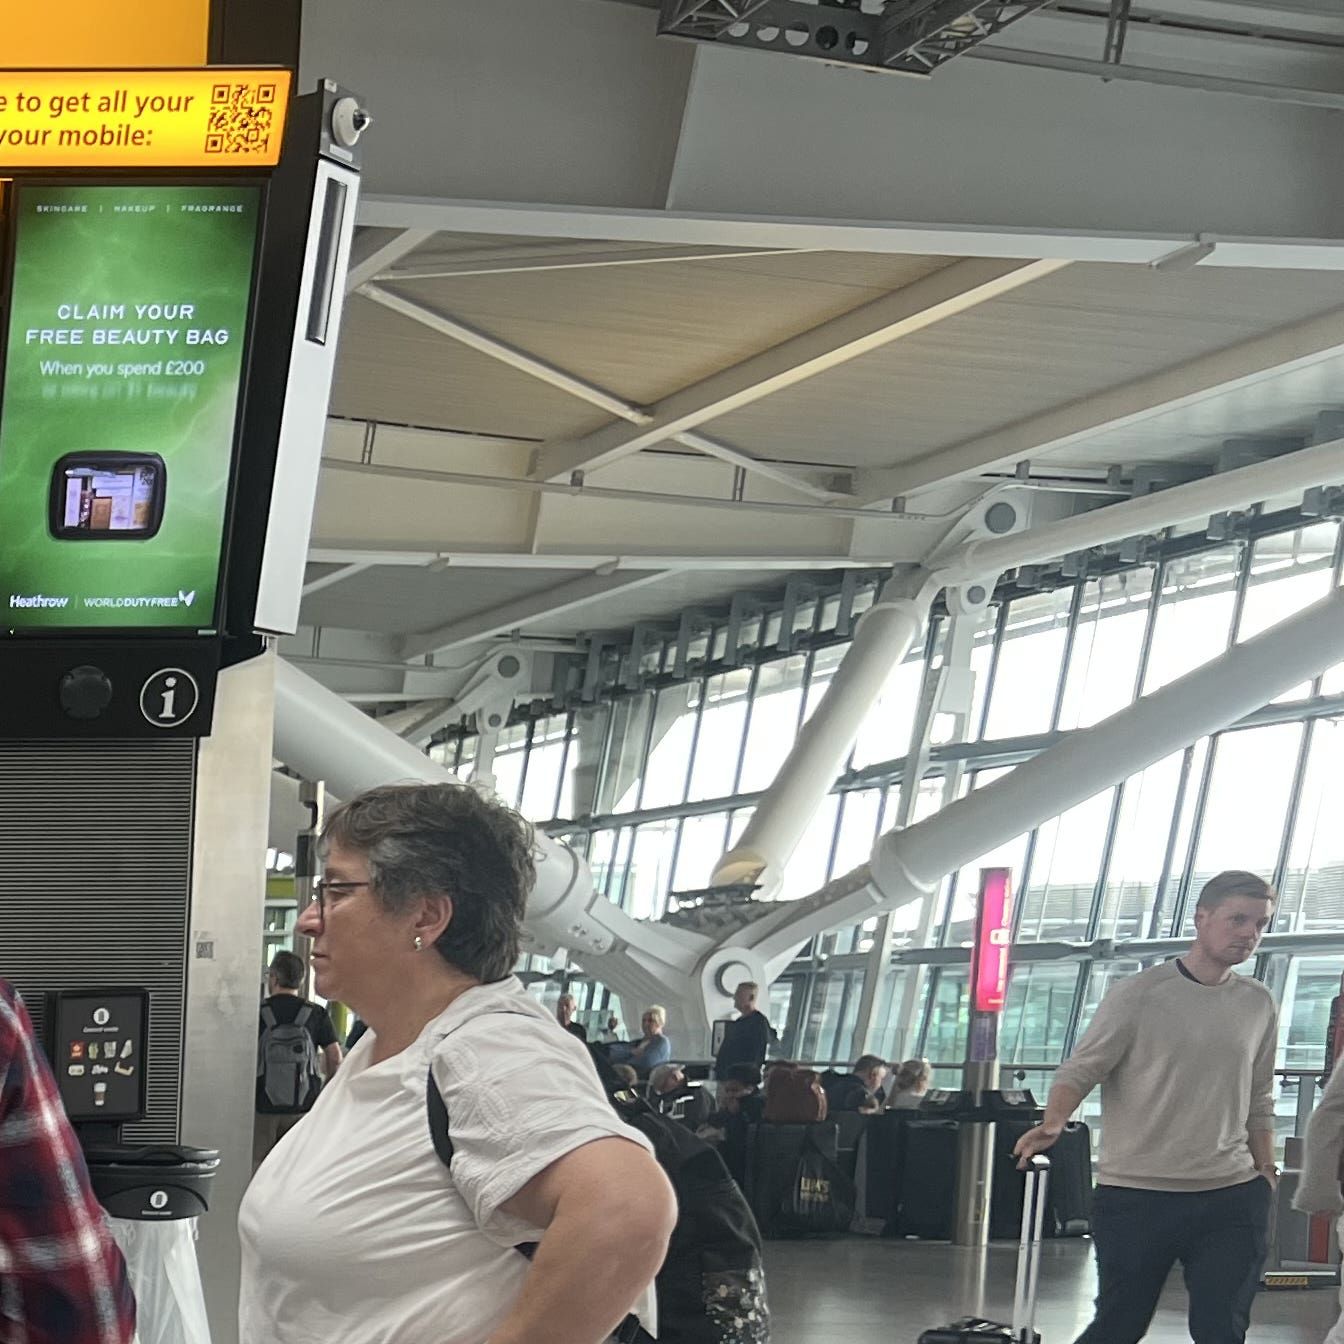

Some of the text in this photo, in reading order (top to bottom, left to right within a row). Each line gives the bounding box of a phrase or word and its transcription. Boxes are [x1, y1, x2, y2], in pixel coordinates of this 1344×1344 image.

[15, 93, 41, 112] to
[49, 93, 90, 119] get
[98, 90, 127, 112] all
[134, 95, 194, 119] your
[58, 124, 154, 146] mobile:
[57, 304, 195, 320] CLAIM YOUR
[25, 329, 229, 345] FREE BEAUTY BAG
[40, 361, 204, 379] When you spend £200
[10, 595, 68, 609] Heathrow
